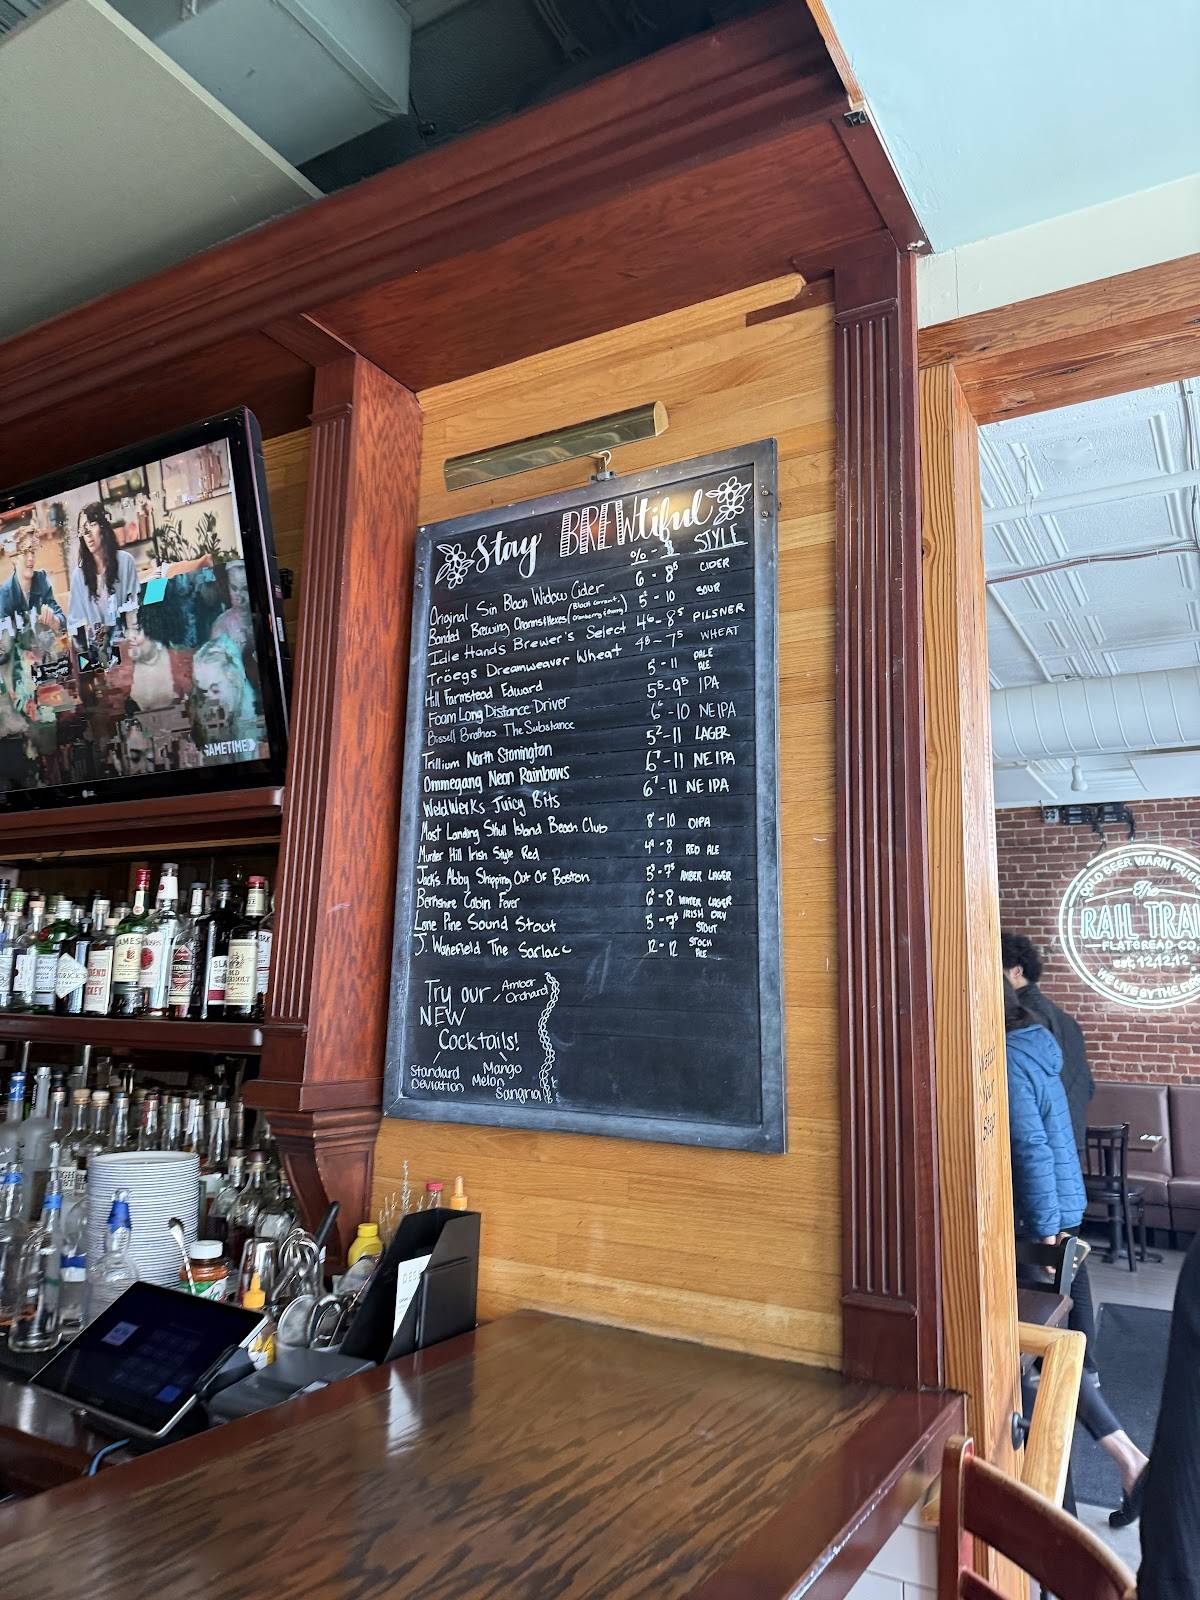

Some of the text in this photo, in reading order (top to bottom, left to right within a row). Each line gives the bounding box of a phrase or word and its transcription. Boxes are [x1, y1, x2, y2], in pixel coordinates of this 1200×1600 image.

[471, 489, 713, 578] Stay BREWtiful
[693, 523, 744, 553] STYLE
[430, 603, 468, 629] Original
[476, 601, 497, 617] Sin
[503, 594, 528, 611] Black
[530, 586, 567, 605] Widow
[571, 580, 605, 599] Cider
[699, 557, 730, 572] CIDER
[428, 628, 460, 647] Banded
[470, 622, 510, 638] Brewing
[696, 582, 721, 596] SOUR
[428, 650, 459, 666] Idle
[464, 642, 506, 659] Hands
[513, 632, 575, 651] Brewer's
[586, 621, 626, 639] Select
[693, 602, 746, 623] PILSNER
[427, 669, 478, 686] Tröegs
[486, 656, 570, 677] Dreamweaver
[576, 643, 623, 664] Wheat
[700, 626, 739, 641] WHEAT
[698, 659, 712, 671] ALE
[425, 689, 440, 707] Hill
[444, 687, 493, 706] Farmstead
[500, 680, 543, 698] Edward
[694, 647, 713, 660] PALE
[429, 712, 456, 727] Foam
[459, 707, 483, 724] Long
[484, 704, 531, 718] Distance
[532, 696, 570, 713] Driver
[699, 675, 720, 694] IPA
[428, 729, 456, 746] Bissell
[460, 727, 496, 742] Brothers
[503, 722, 524, 737] The
[524, 720, 575, 734] Substance
[422, 751, 460, 770] Trillium
[466, 751, 494, 768] North
[497, 742, 552, 764] Stonington
[695, 725, 731, 741] LAGER
[424, 775, 483, 796] Ommegang
[488, 770, 515, 788] Neon
[519, 765, 570, 785] Rainbows
[491, 797, 527, 816] Juicy
[532, 790, 561, 809] Bits
[447, 820, 480, 845] Landing
[484, 819, 507, 838] Skull
[512, 818, 542, 837] Island
[548, 815, 578, 834] Beach
[582, 817, 609, 833] Club
[449, 847, 462, 862] Hill
[468, 846, 488, 862] Irish
[521, 845, 540, 861] Red
[685, 844, 700, 855] RED
[707, 844, 720, 856] ALE
[417, 865, 441, 887] Jack's
[447, 867, 469, 893] Abby
[475, 867, 513, 892] Shipping
[514, 871, 531, 884] Out
[552, 867, 591, 887] Boston
[680, 870, 702, 882] AMBER
[708, 869, 731, 882] LAGER
[1080, 855, 1200, 897] COLD BEER WARM FRIEN
[417, 888, 732, 910] Berkshire Cabin Fever WINTER LAGER
[1133, 880, 1160, 899] The
[414, 910, 438, 931] Lone
[443, 911, 462, 931] Pine
[467, 913, 508, 932] Sound
[515, 915, 556, 933] Stout
[683, 908, 703, 919] IRISH
[711, 910, 727, 921] DRY
[696, 921, 718, 934] STOUT
[1080, 902, 1139, 940] RAIL
[413, 932, 428, 956] J.
[487, 937, 509, 956] The
[689, 937, 712, 947] STOCK
[695, 948, 707, 958] ALE
[1102, 940, 1173, 951] FLATBREAD
[424, 978, 537, 1013] Try our Amber
[505, 984, 549, 1004] Orchard
[1097, 967, 1116, 985] WE
[1114, 979, 1139, 997] LIVE
[1139, 988, 1157, 999] BY
[1157, 985, 1181, 998] THE
[419, 1005, 467, 1027] NEW
[438, 1028, 520, 1051] Cocktails!
[410, 1064, 460, 1080] Standard
[472, 1074, 505, 1087] Melon
[482, 1061, 523, 1079] Mango
[411, 1078, 465, 1093] Deviation
[495, 1087, 542, 1104] Sangria
